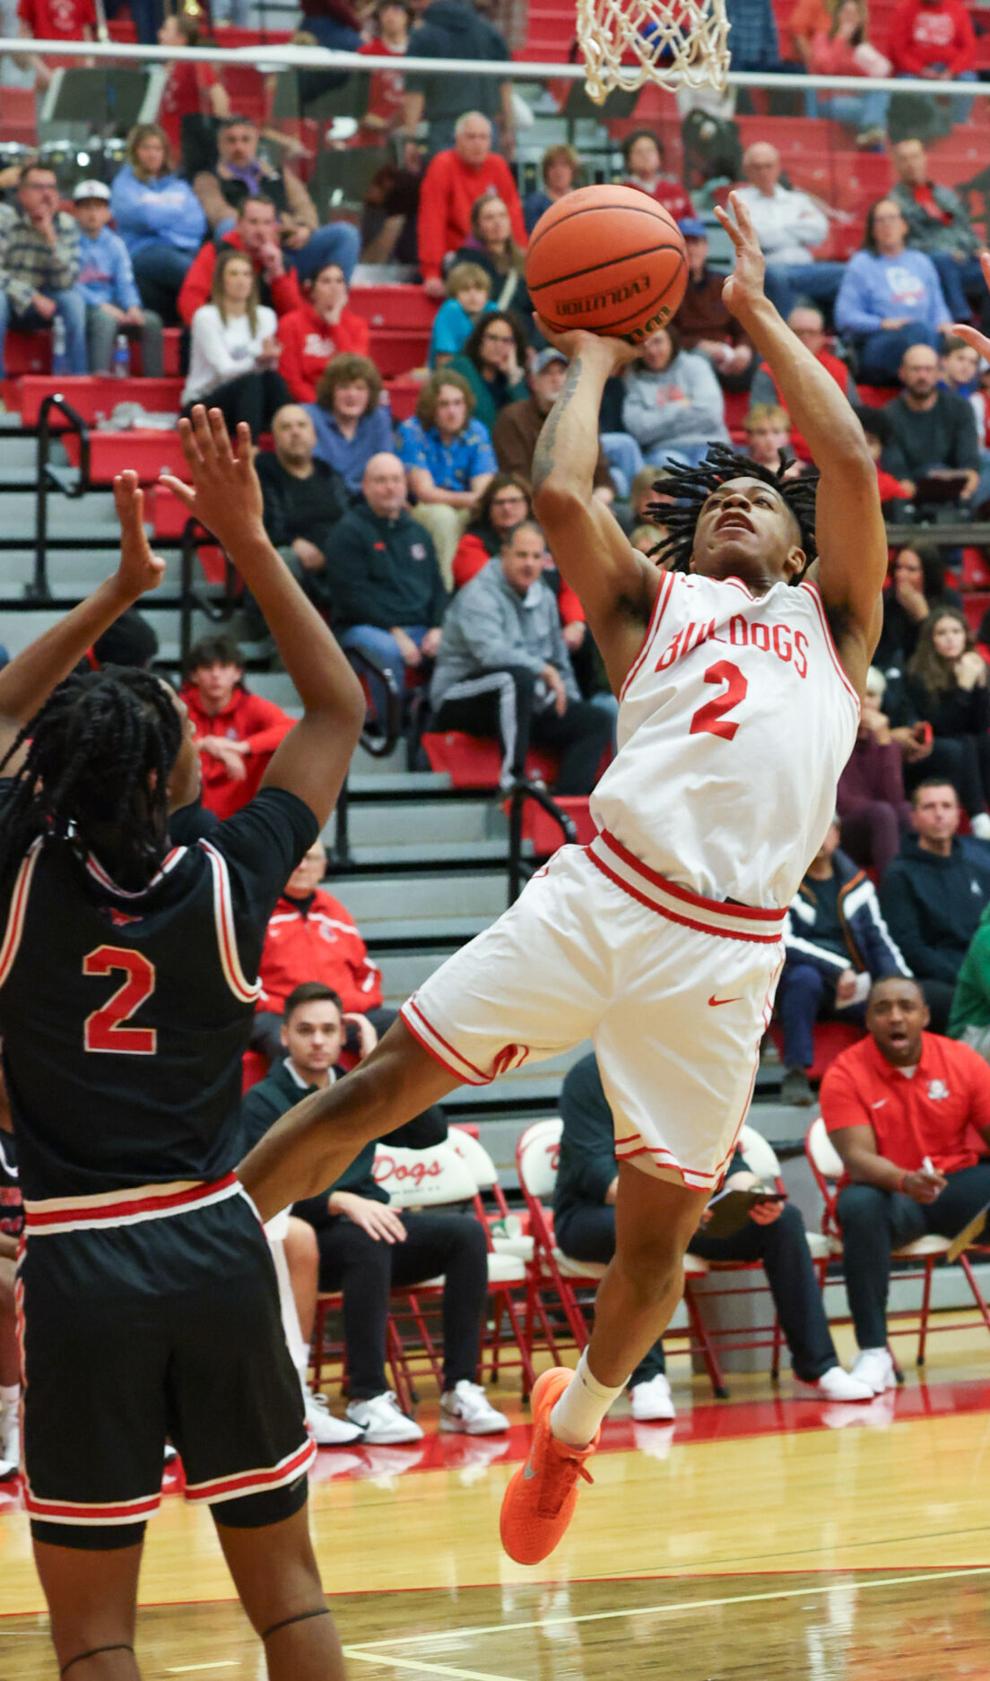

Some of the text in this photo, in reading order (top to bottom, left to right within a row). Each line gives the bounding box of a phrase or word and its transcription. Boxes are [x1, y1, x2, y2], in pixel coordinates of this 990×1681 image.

[555, 275, 650, 316] EVOLUTION
[654, 613, 809, 679] BULLDOGS
[689, 659, 748, 741] 2
[82, 944, 157, 1055] 2
[371, 1154, 443, 1187] Dogs
